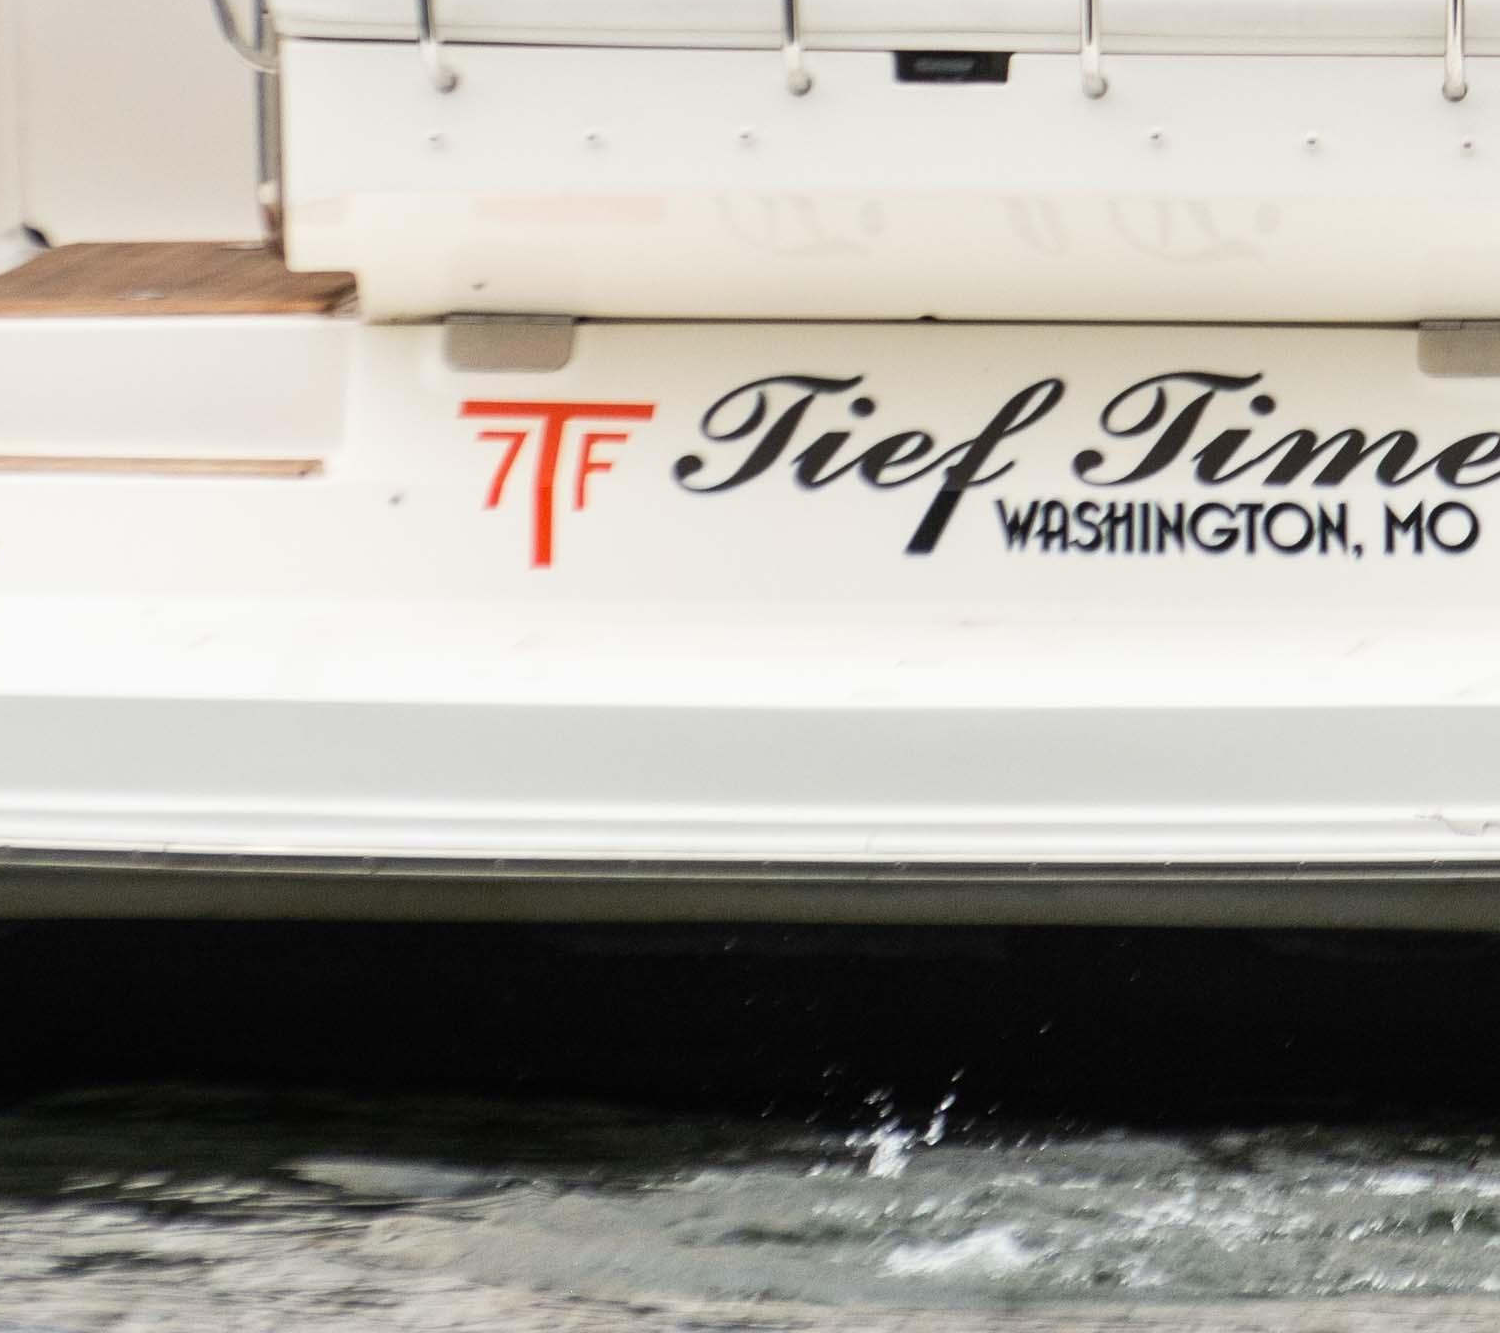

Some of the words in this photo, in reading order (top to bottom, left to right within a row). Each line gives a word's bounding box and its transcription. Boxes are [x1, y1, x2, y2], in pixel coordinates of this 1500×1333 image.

[674, 373, 1067, 555] Tief
[994, 498, 1364, 559] WASHINGTON,
[1383, 499, 1481, 555] MO
